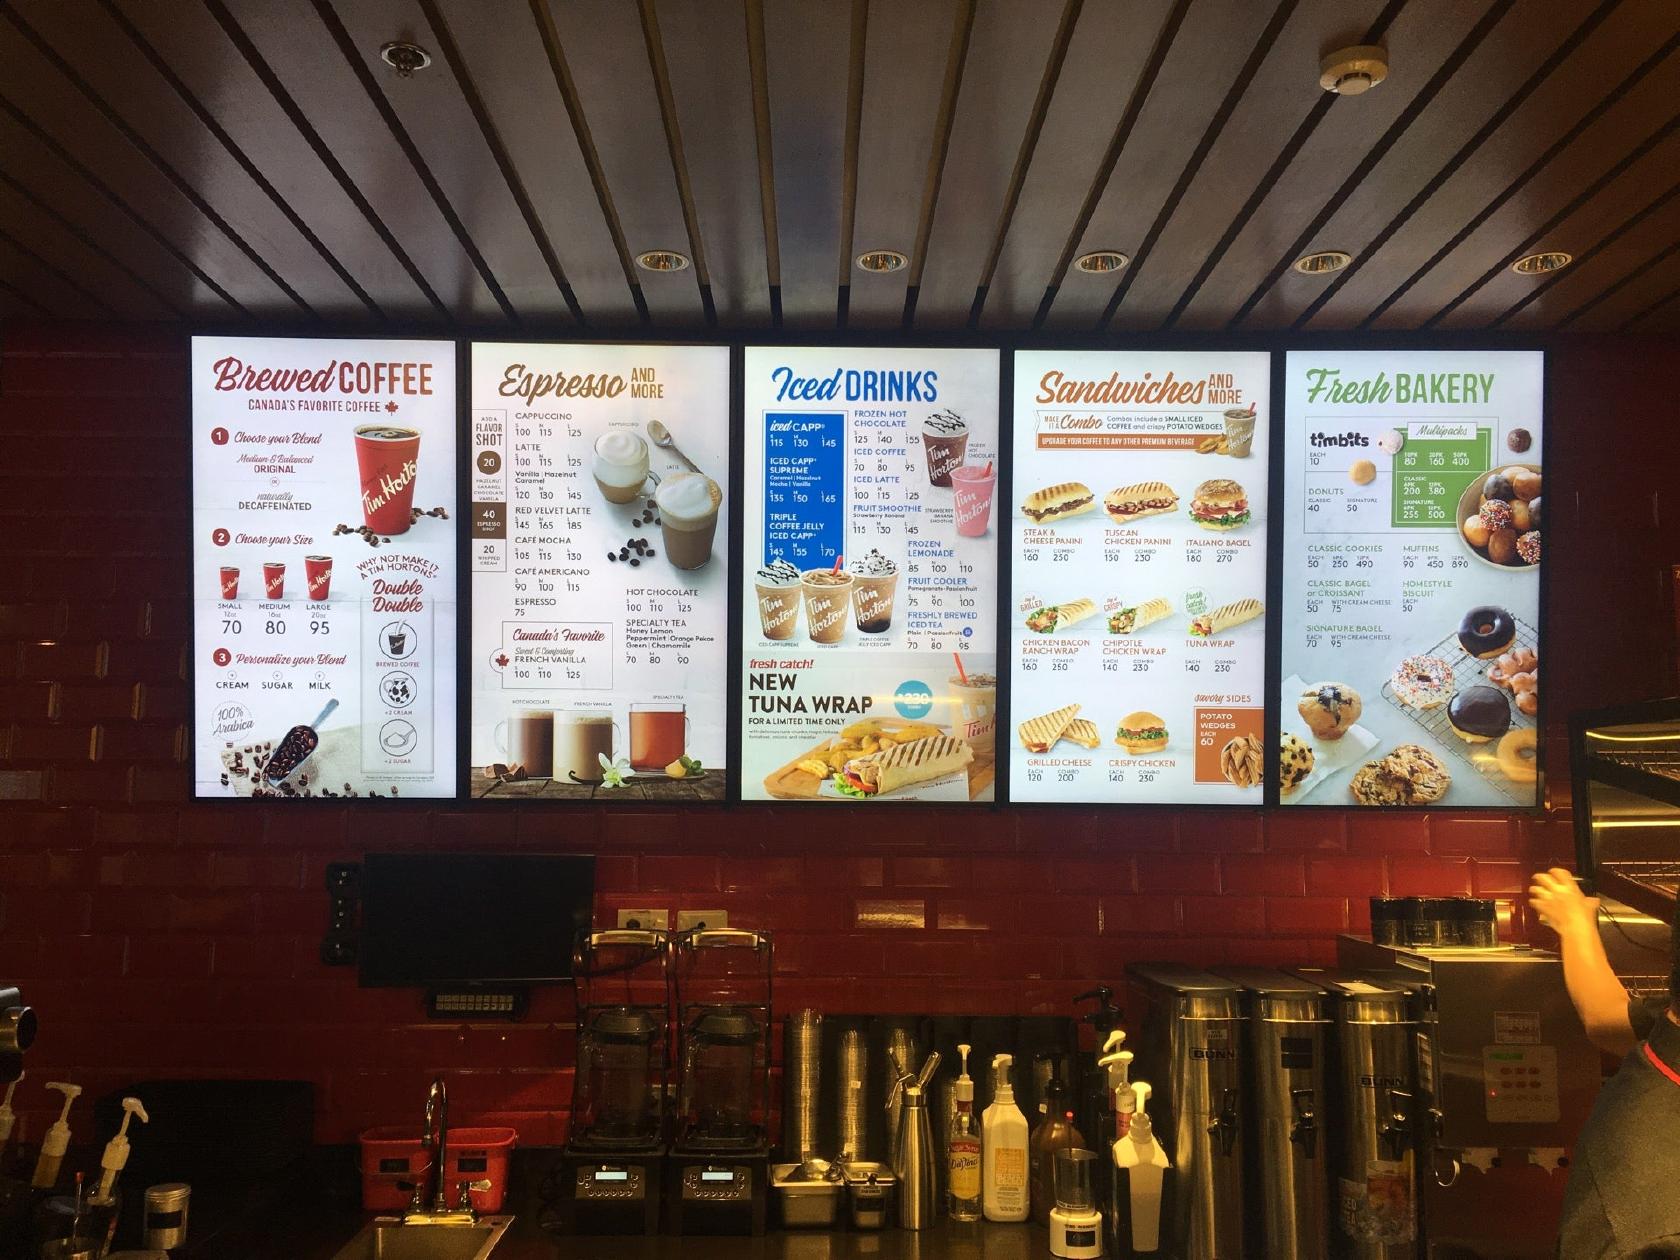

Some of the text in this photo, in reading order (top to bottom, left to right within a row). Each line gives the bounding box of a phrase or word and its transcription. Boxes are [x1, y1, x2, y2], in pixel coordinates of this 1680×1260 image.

[213, 356, 432, 395] Brewed COFFEE
[499, 364, 654, 406] Espresso AND
[631, 384, 664, 398] MORE
[772, 367, 937, 402] Iced DRINKS
[1036, 371, 1232, 405] Sandwiches AND
[1306, 368, 1494, 404] Fresh BAKERY
[1208, 390, 1242, 404] MORE
[248, 399, 380, 412] CANADA'S FAVORITE COFFEE
[476, 424, 502, 432] FLAVOR
[1061, 414, 1102, 429] Combo
[216, 432, 221, 440] 1
[1417, 425, 1467, 437] Multipacks
[234, 432, 322, 445] Choose your Blend
[476, 434, 502, 446] SHOT
[1310, 432, 1369, 447] timbits
[254, 465, 296, 474] ORIGINAL
[239, 502, 311, 510] DECAFFEINATED
[535, 507, 564, 515] VELVET
[567, 507, 591, 515] LATTE
[218, 533, 224, 542] 2
[235, 533, 313, 546] Choose your Size
[515, 536, 571, 545] CAFÉ MOCHA
[515, 567, 589, 576] CAFÉ AMERICANO
[373, 579, 423, 595] Double
[373, 597, 423, 613] Double
[515, 598, 556, 606] ESPRESSO
[222, 621, 241, 634] 70
[266, 621, 286, 634] 80
[310, 621, 330, 635] 95
[626, 619, 669, 627] SPECIALTY
[513, 629, 605, 642] Canada's Favorite
[219, 653, 226, 662] 3
[236, 654, 347, 666] Personalize your Blend
[750, 659, 814, 668] fresh catch!
[216, 681, 248, 689] CREAM
[262, 681, 293, 689] SUGAR
[749, 674, 797, 690] NEW
[749, 696, 873, 713] TUNA WRAP
[1195, 694, 1224, 704] savory
[218, 708, 244, 721] 100%
[213, 720, 254, 735] Arabica
[1194, 1049, 1235, 1060] BUNN
